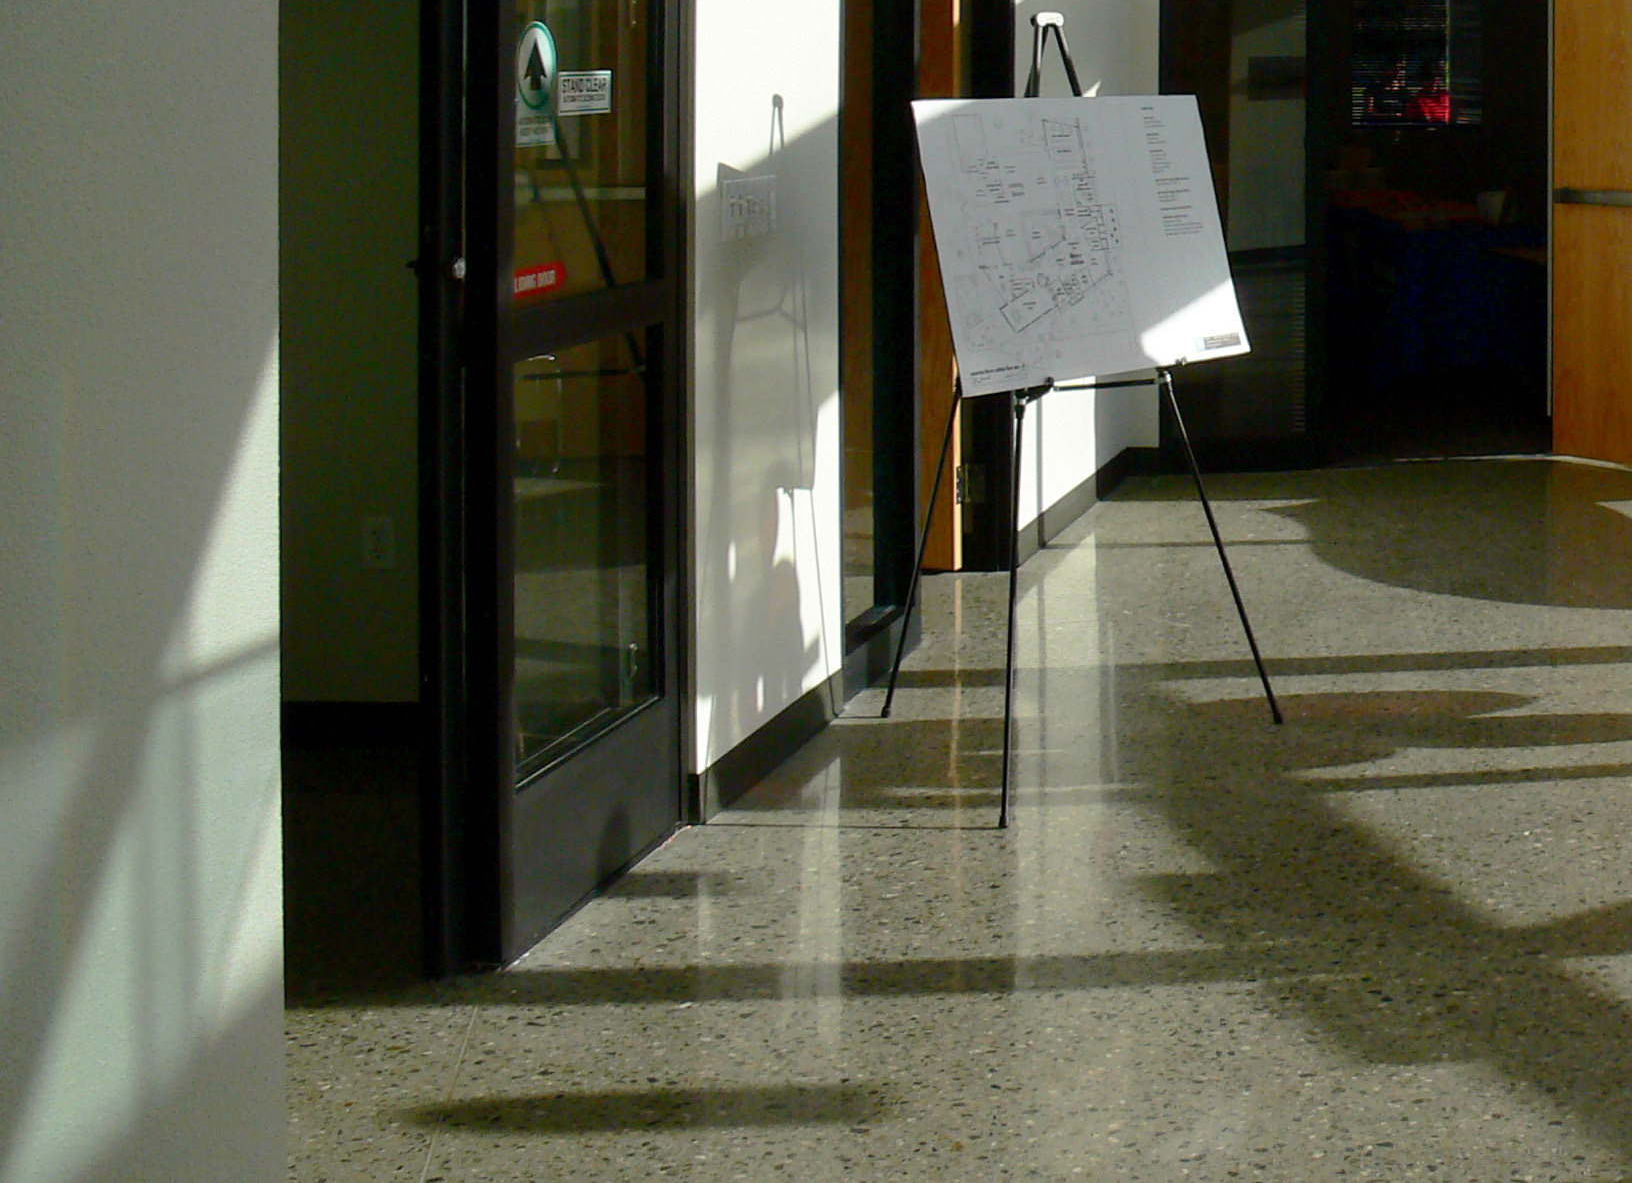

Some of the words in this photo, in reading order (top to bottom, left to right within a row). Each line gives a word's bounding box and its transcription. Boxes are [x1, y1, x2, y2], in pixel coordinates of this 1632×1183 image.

[562, 78, 584, 94] STAND
[585, 77, 607, 92] CLEAR
[514, 273, 537, 293] LIDING
